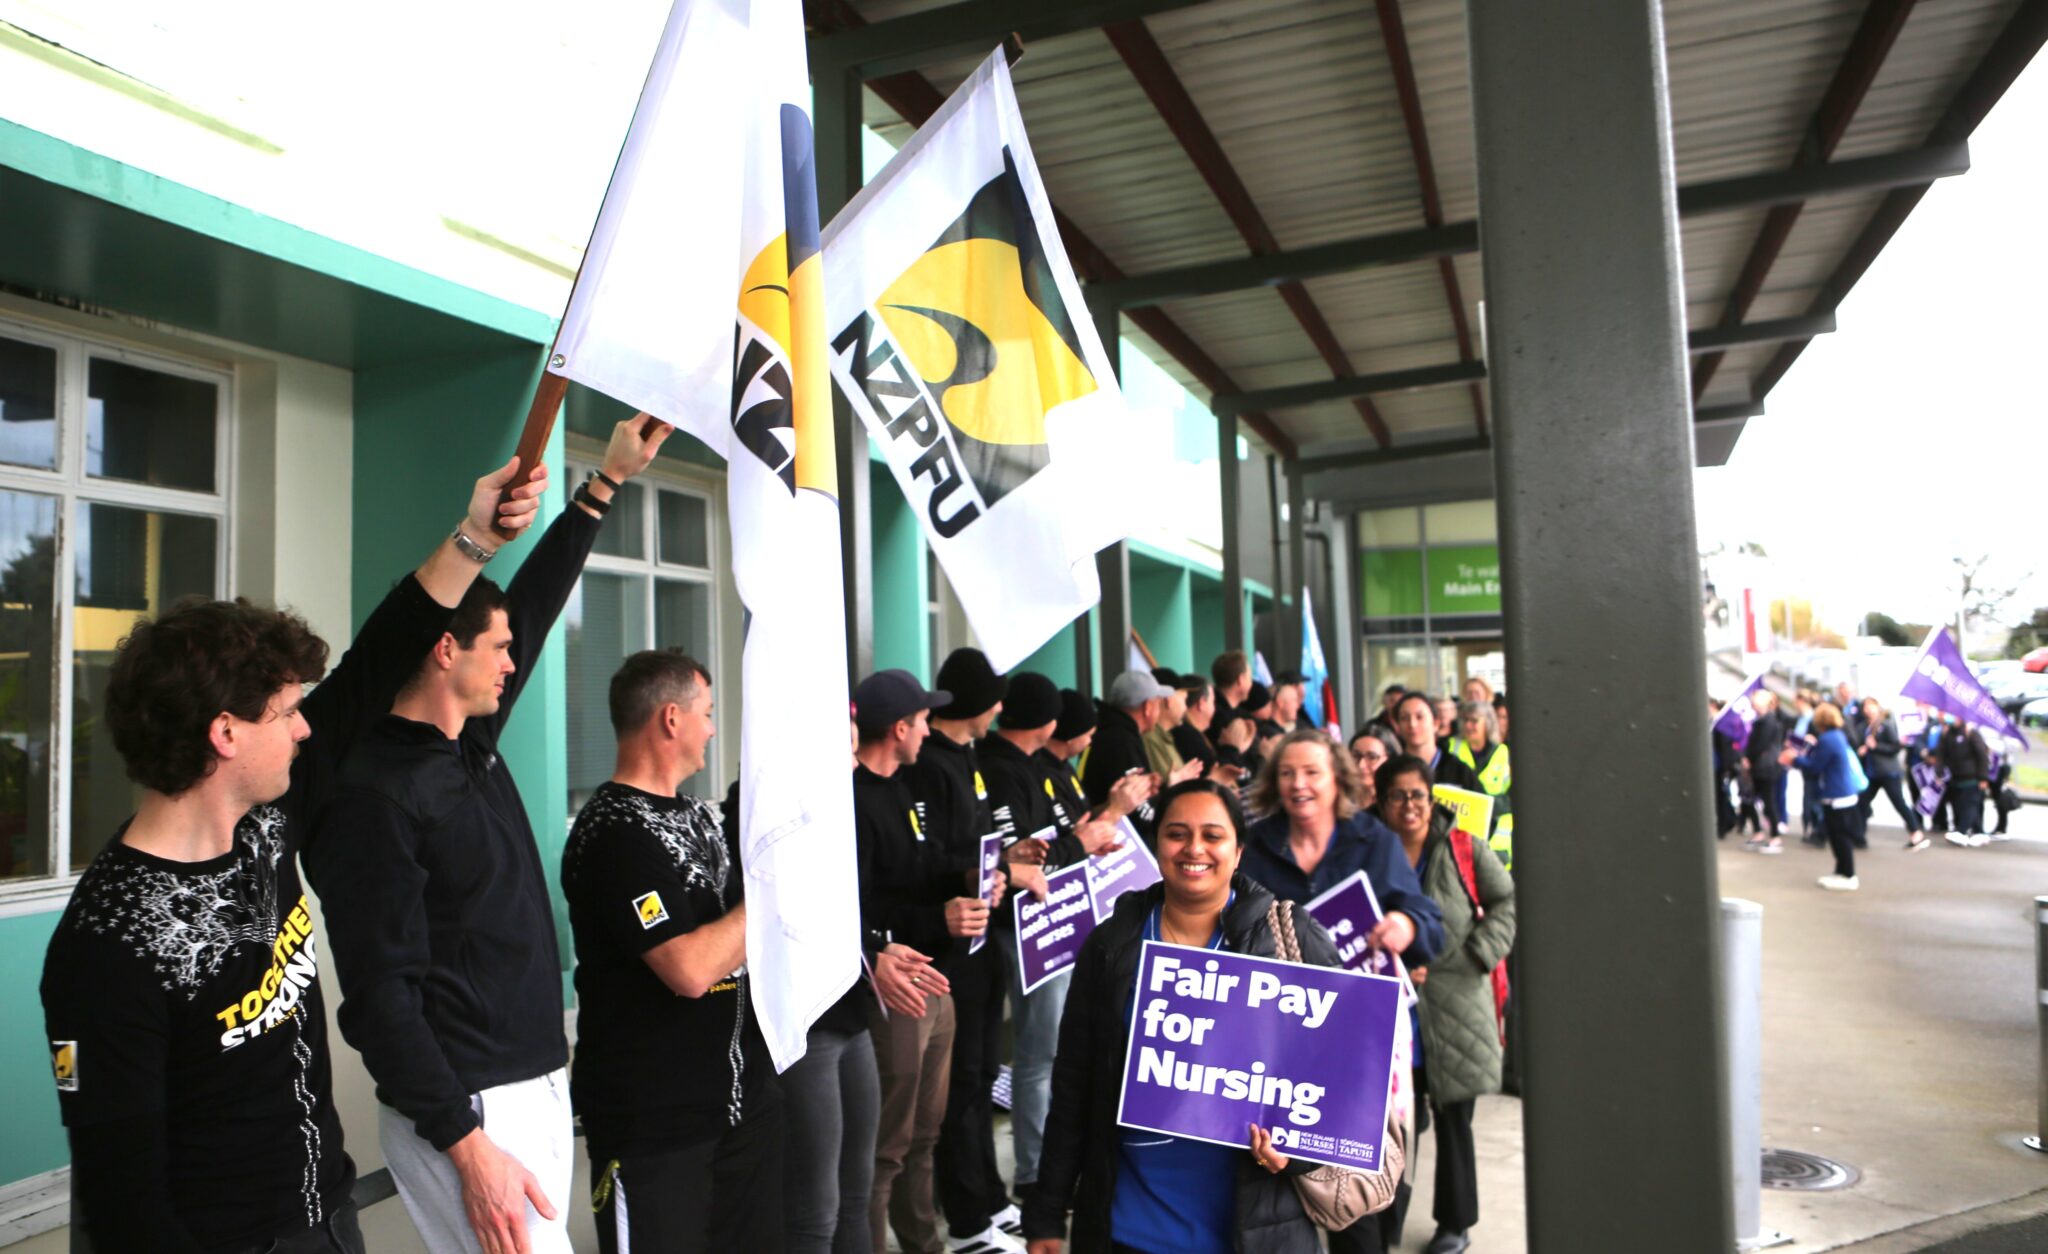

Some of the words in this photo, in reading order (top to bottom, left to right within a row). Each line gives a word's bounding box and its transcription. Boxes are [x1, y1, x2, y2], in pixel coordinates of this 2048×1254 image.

[831, 310, 981, 538] NZPFU
[1444, 582, 1482, 596] Main
[1020, 914, 1051, 941] needs
[1050, 894, 1090, 922] valued
[1327, 918, 1354, 943] re
[1036, 923, 1075, 951] nurses
[1149, 955, 1241, 1002] Fair
[1247, 971, 1339, 1028] Pay
[1142, 999, 1216, 1045] for
[1136, 1046, 1326, 1126] Nursing
[1300, 1138, 1334, 1149] NURSES
[1339, 1146, 1373, 1158] TAPUHI
